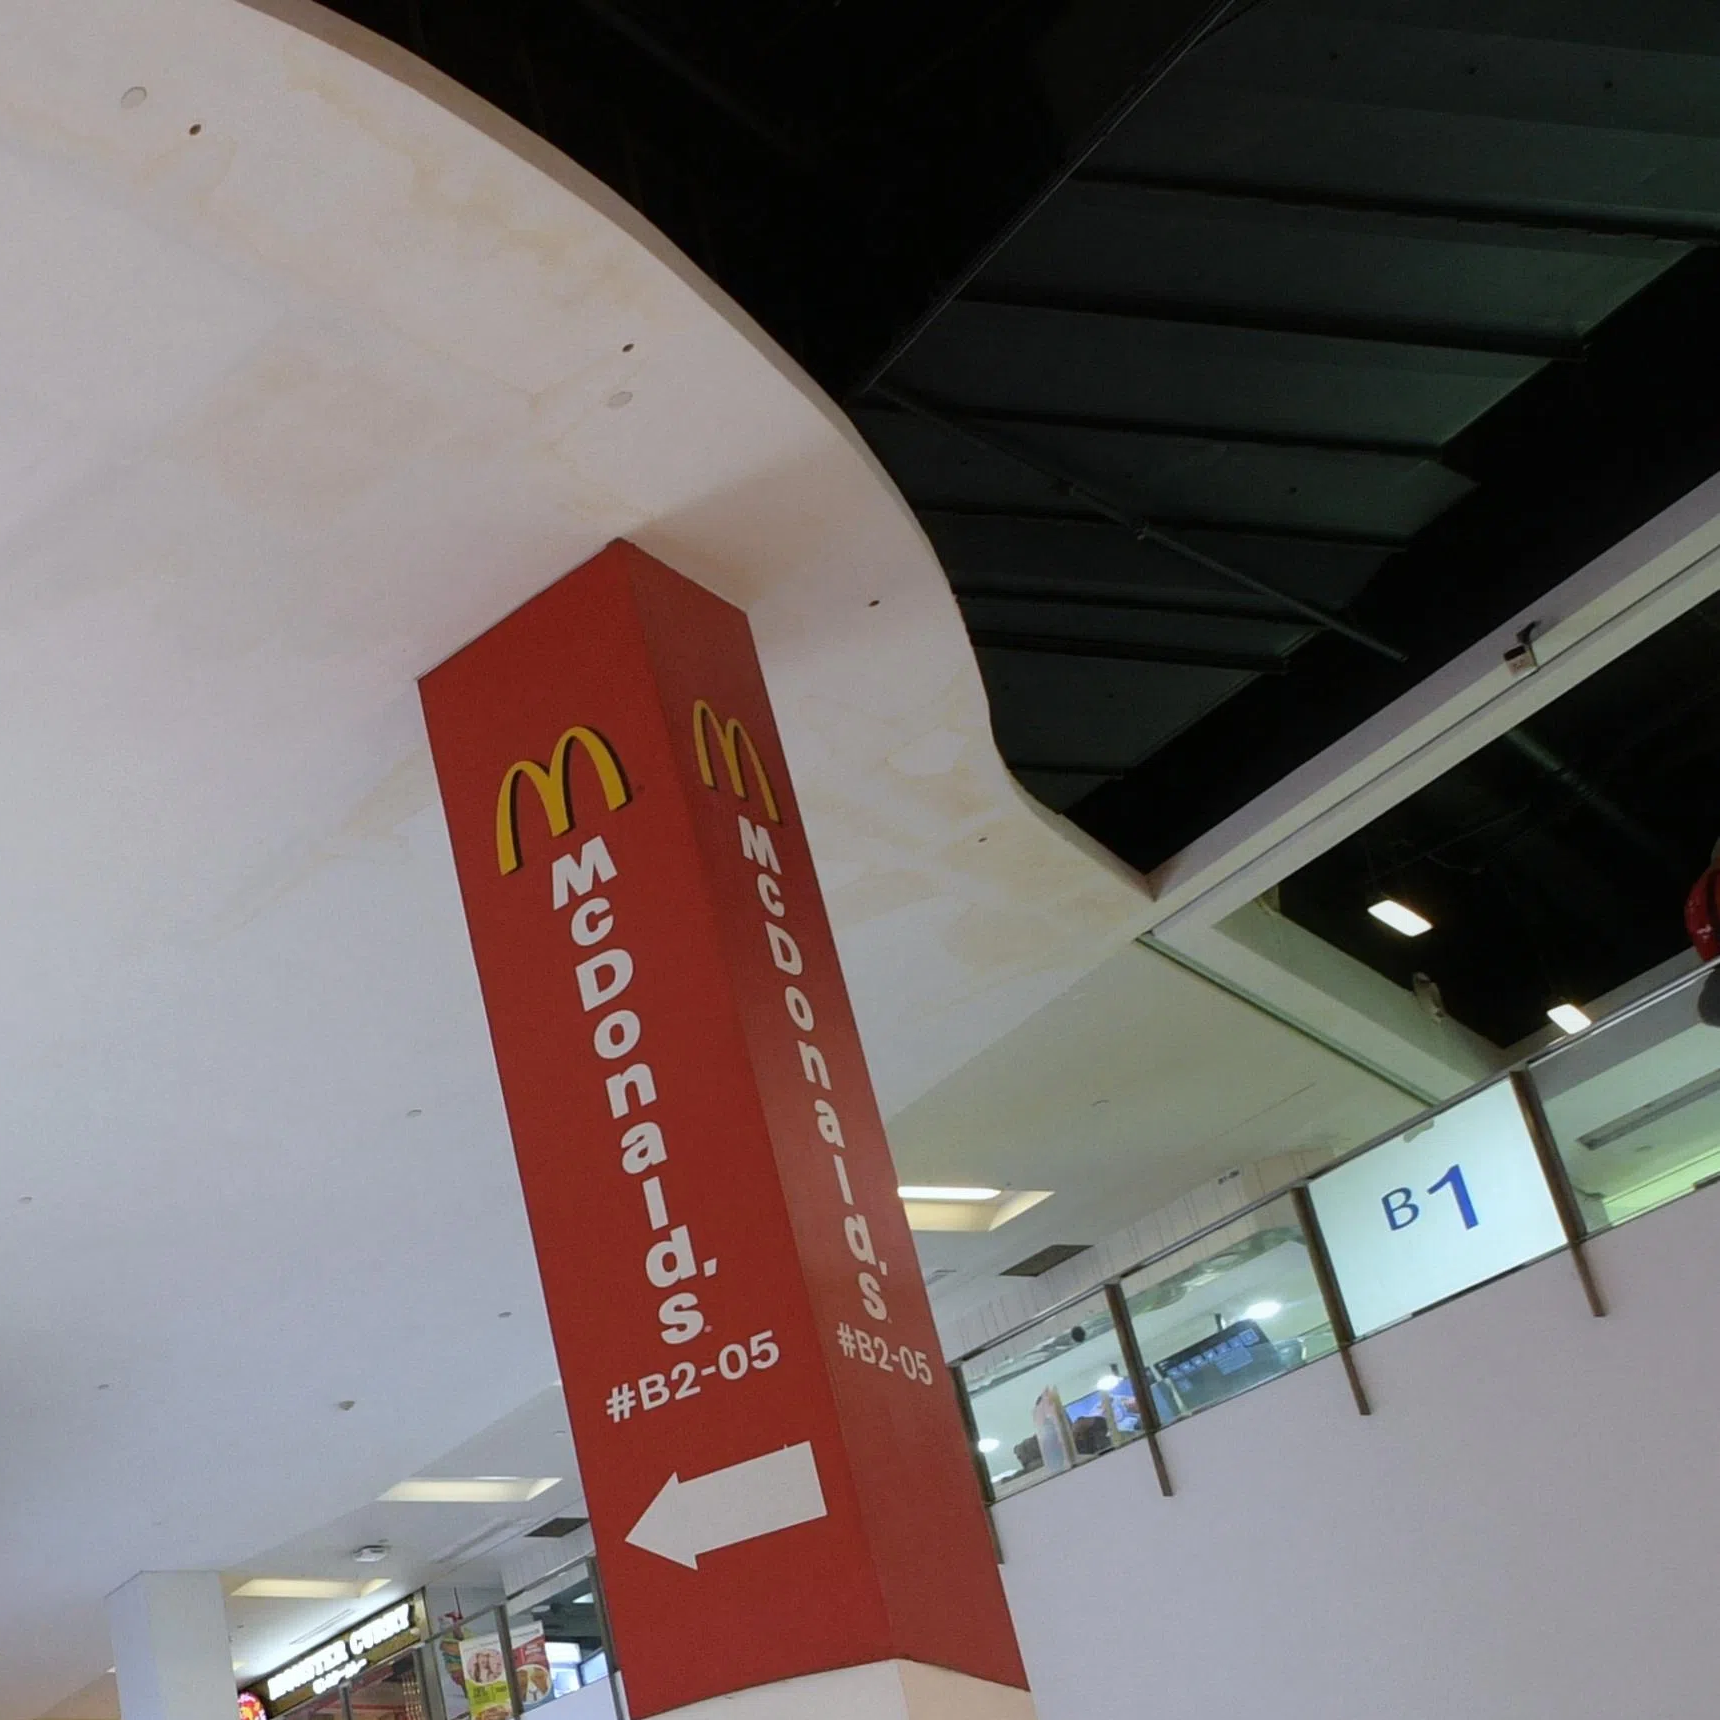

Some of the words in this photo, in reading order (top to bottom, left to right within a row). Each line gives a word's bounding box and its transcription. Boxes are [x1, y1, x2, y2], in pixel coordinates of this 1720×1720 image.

[552, 836, 718, 1345] McDonald's
[605, 1329, 780, 1423] #B2-05
[836, 1320, 933, 1386] #B2-05
